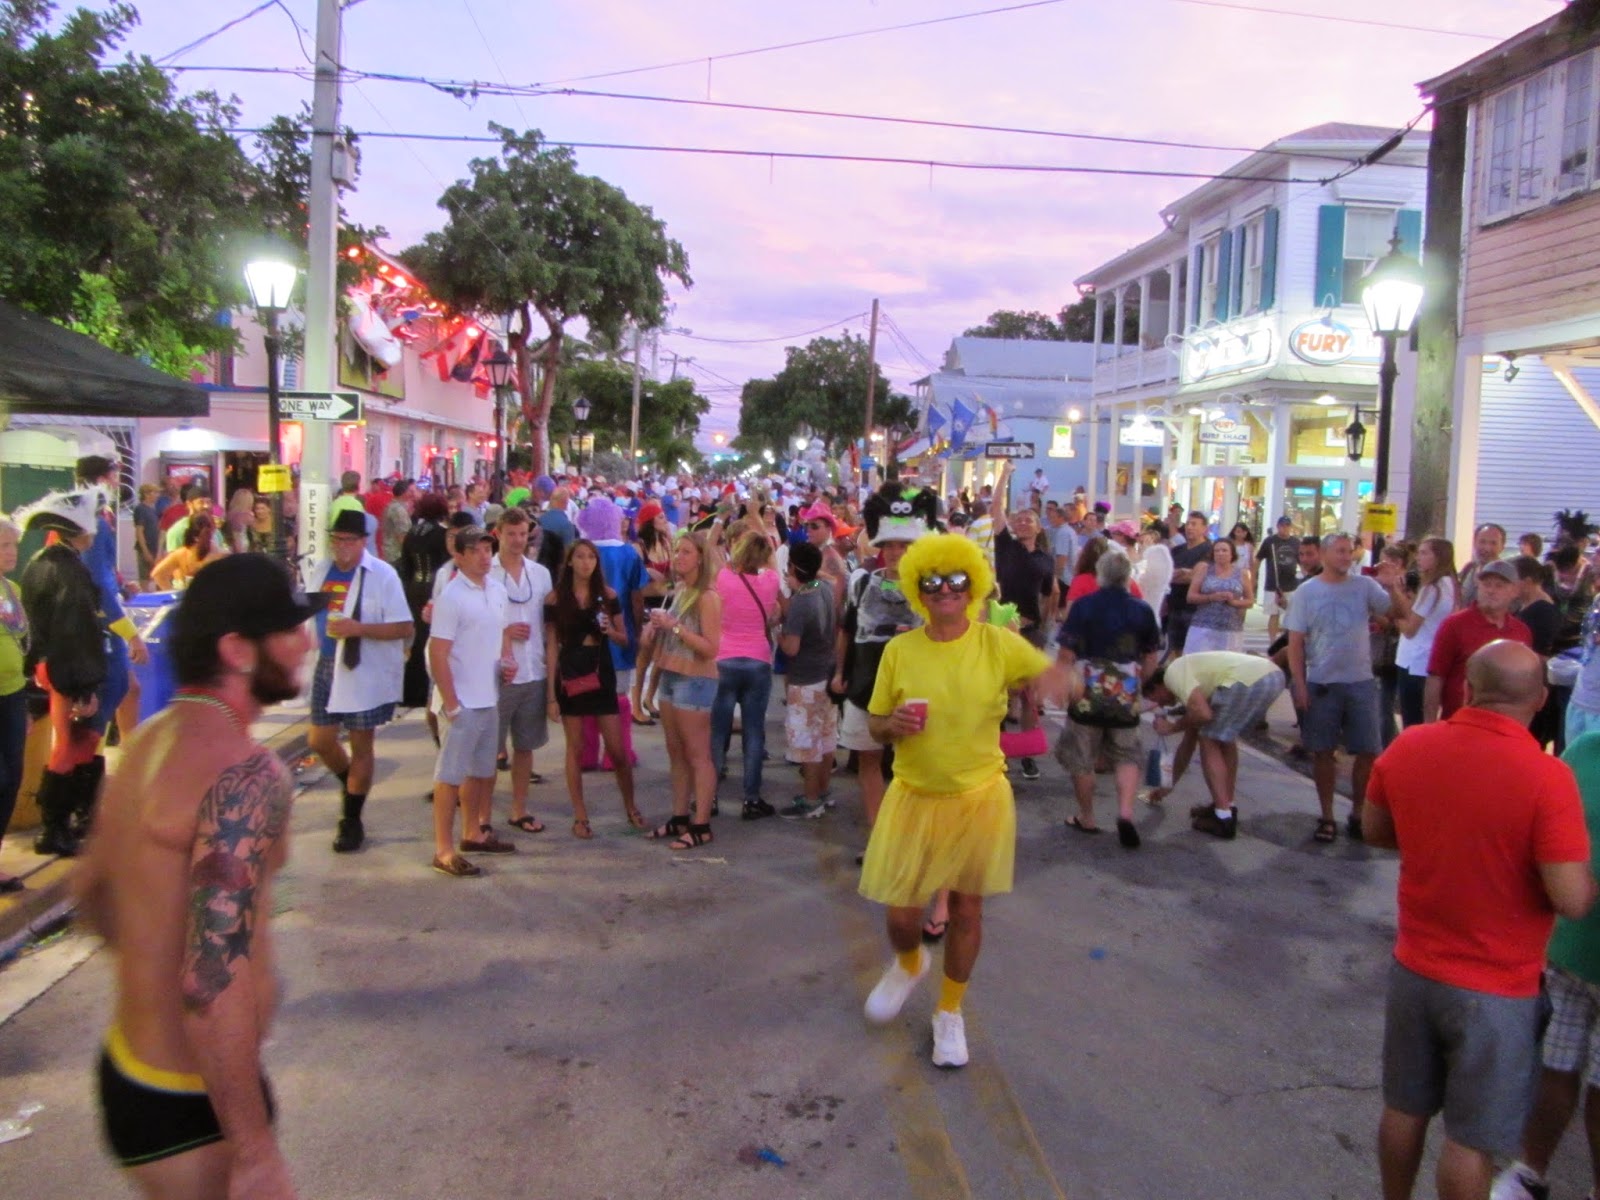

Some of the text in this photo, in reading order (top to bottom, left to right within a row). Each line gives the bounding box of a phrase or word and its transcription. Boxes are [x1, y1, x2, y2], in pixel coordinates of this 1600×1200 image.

[1297, 333, 1350, 353] FURY
[280, 400, 332, 412] ONE WAY
[308, 489, 317, 570] PETRON
